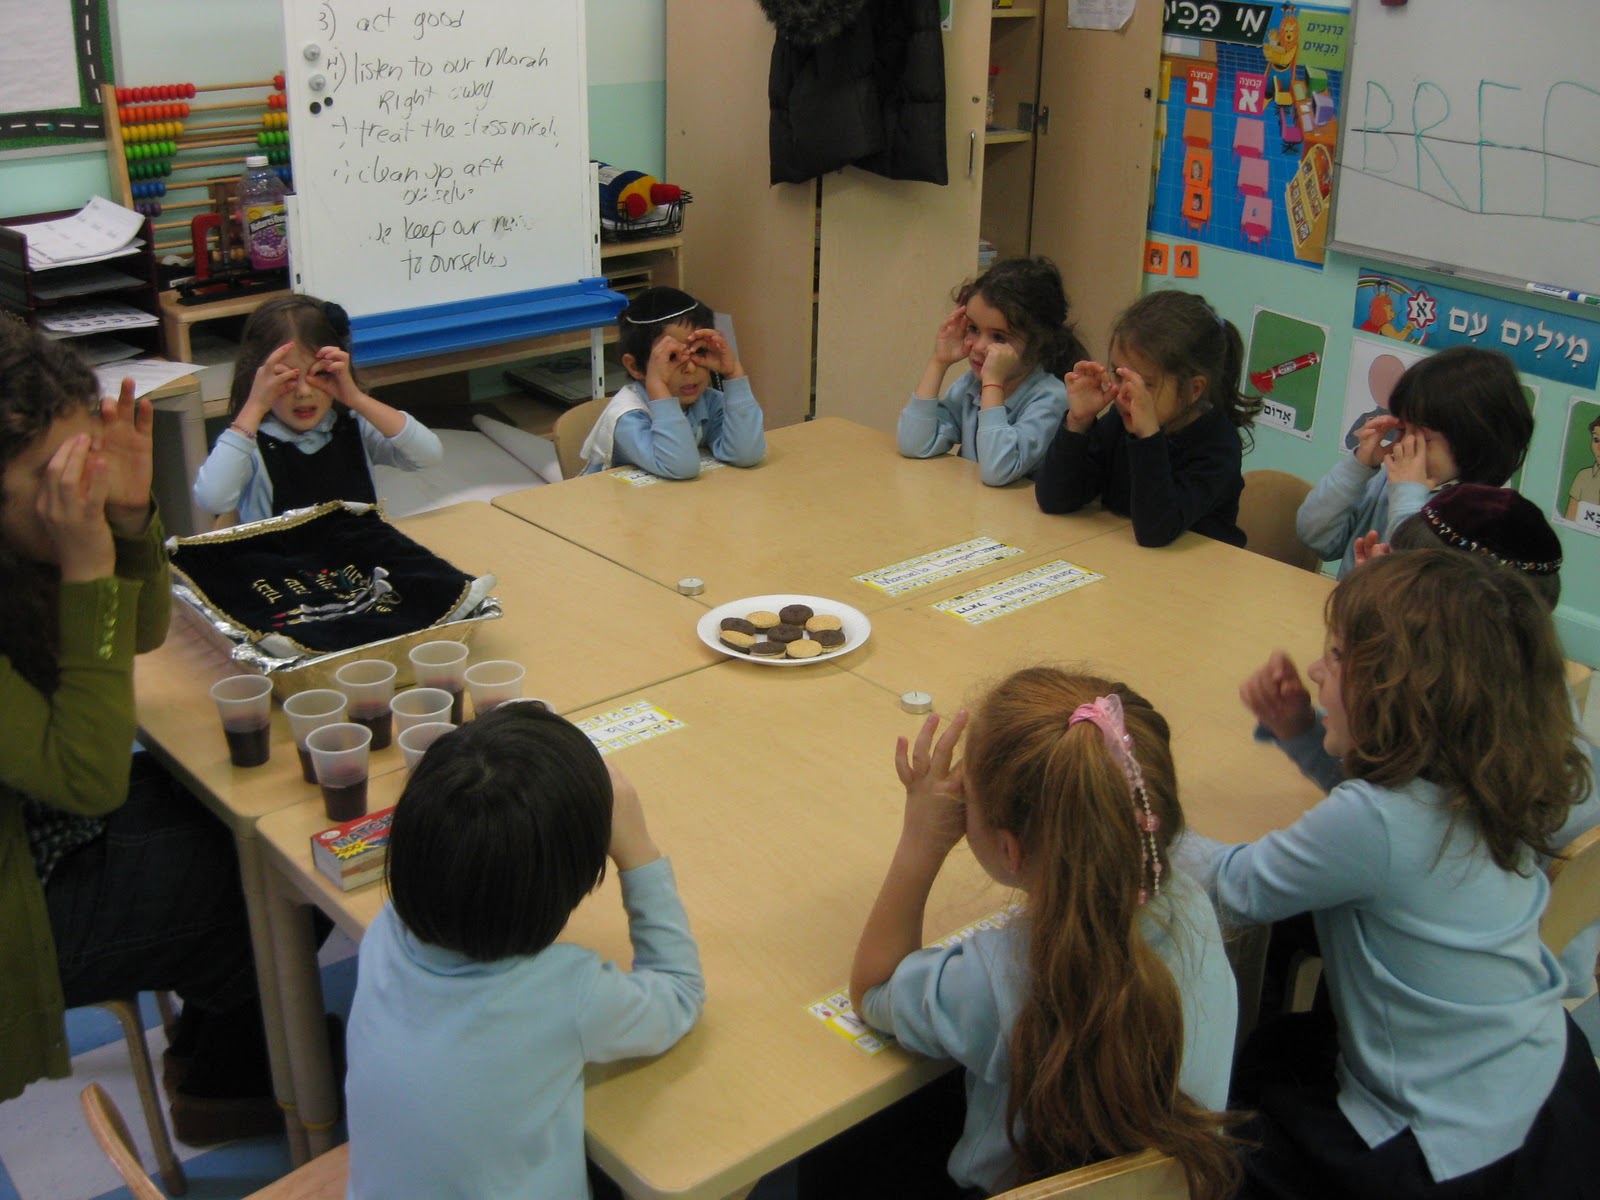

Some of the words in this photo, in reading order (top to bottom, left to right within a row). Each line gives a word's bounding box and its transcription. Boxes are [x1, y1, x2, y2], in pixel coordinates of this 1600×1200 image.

[319, 2, 336, 41] 3)
[356, 7, 395, 33] act
[413, 9, 464, 41] good
[355, 52, 403, 85] listen
[408, 56, 433, 77] to
[443, 59, 476, 74] our
[486, 47, 548, 68] Morah
[1191, 81, 1208, 104] ב
[1238, 88, 1259, 112] א
[354, 120, 415, 147] treat
[421, 118, 455, 139] the
[359, 156, 418, 184] clean
[425, 162, 454, 188] up
[403, 216, 446, 248] keep
[453, 219, 485, 236] our
[400, 250, 423, 281] to
[1416, 301, 1427, 318] א
